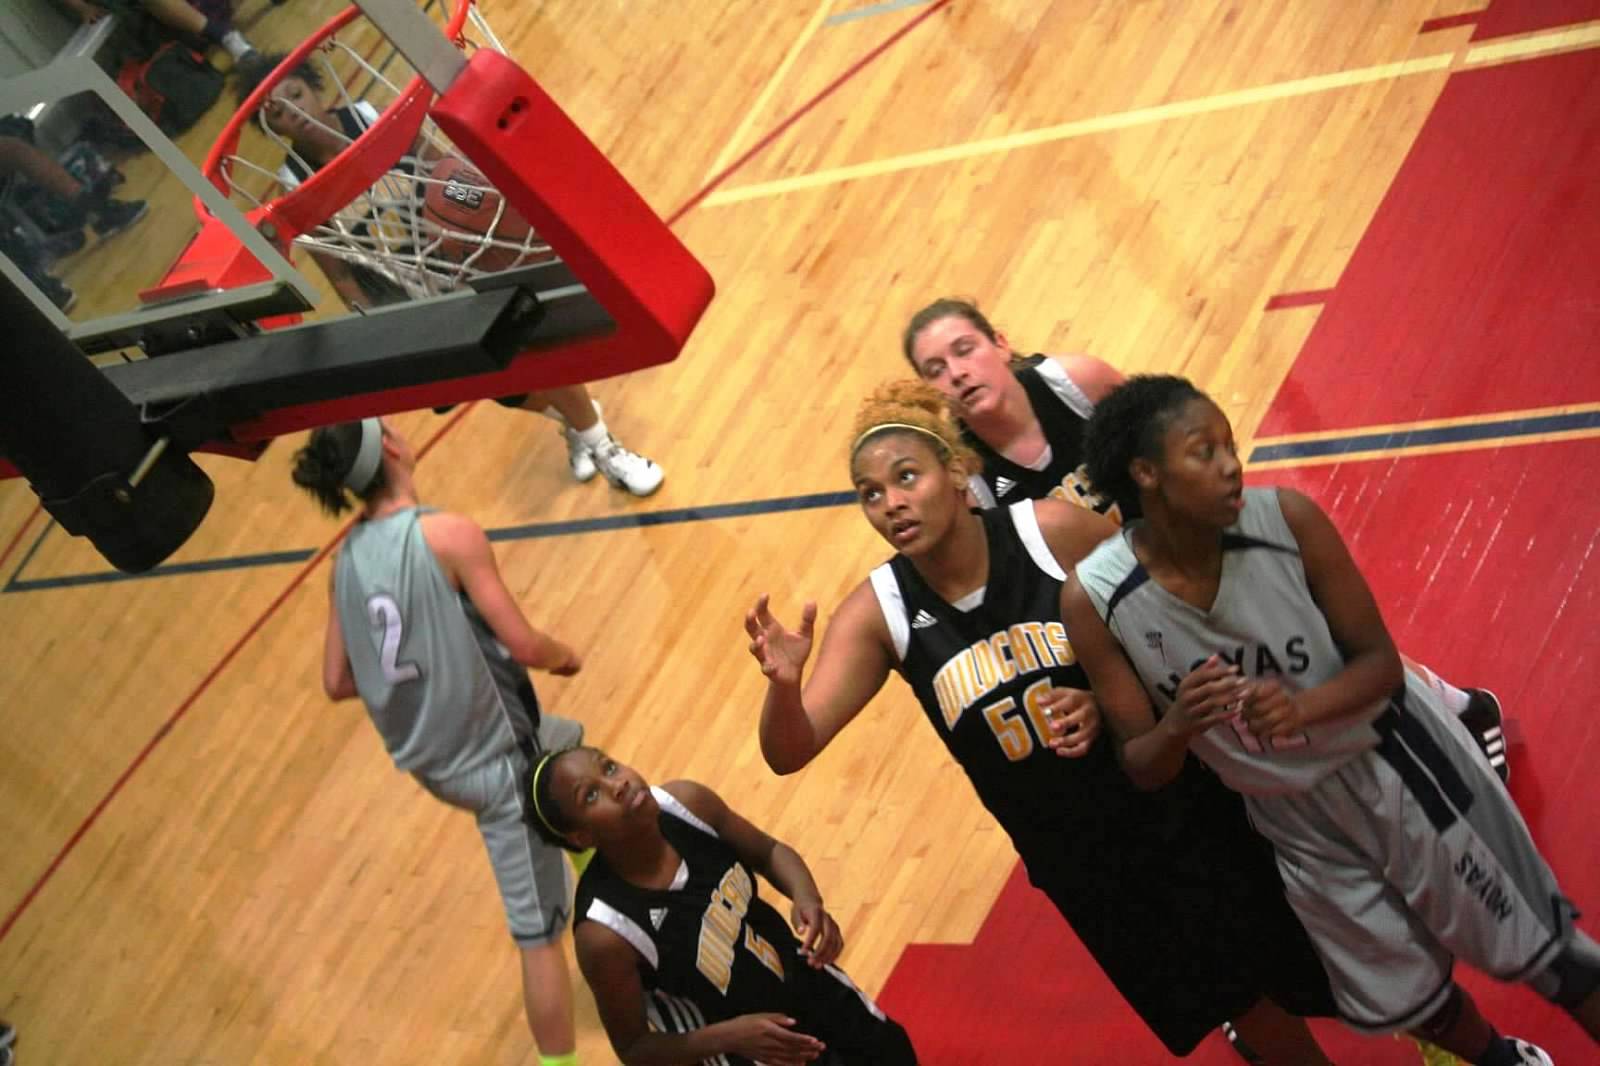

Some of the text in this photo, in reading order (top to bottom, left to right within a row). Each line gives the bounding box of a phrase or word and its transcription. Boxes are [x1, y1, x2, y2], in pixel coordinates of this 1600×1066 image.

[366, 595, 422, 687] 2
[932, 621, 1077, 732] WILDCATS
[1156, 635, 1311, 701] YAS
